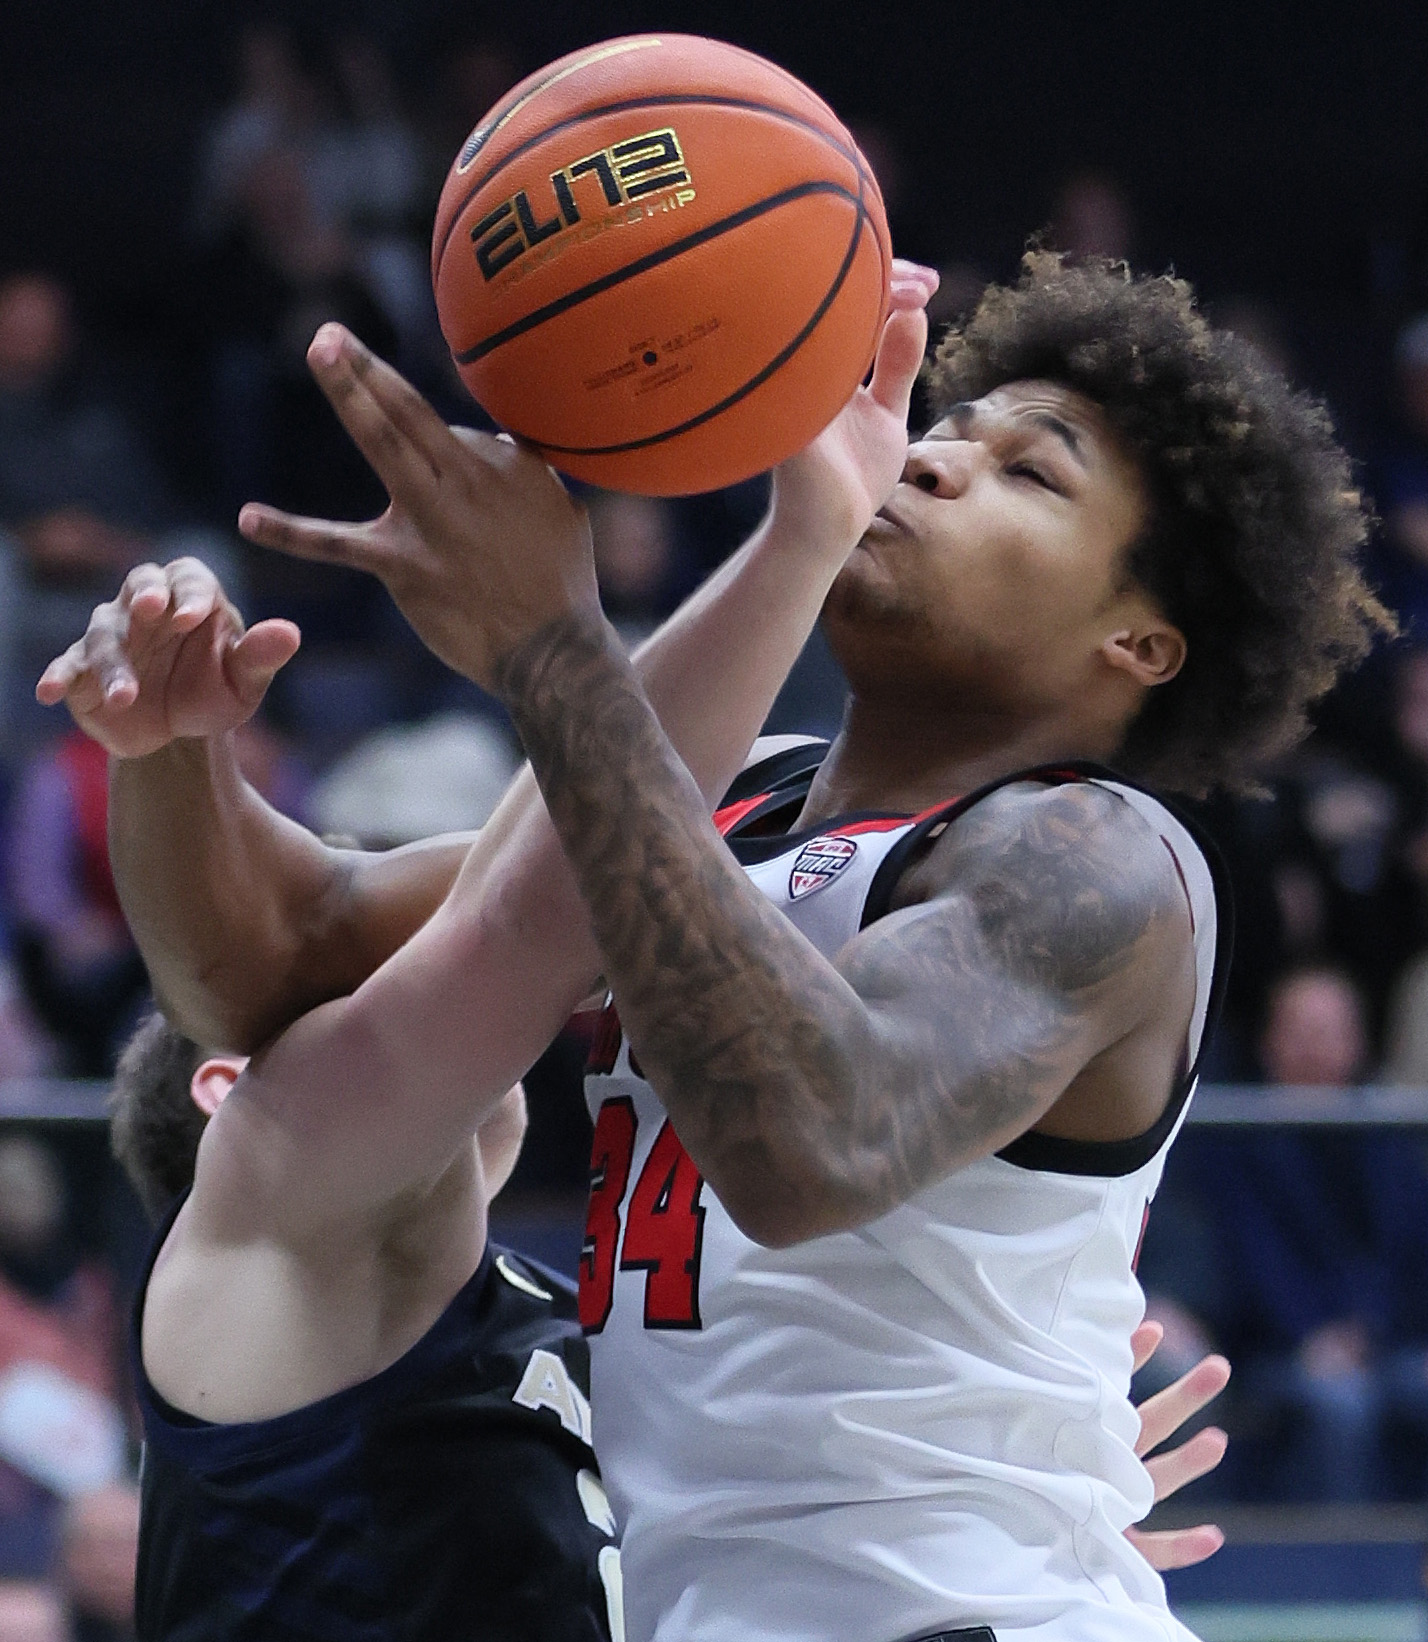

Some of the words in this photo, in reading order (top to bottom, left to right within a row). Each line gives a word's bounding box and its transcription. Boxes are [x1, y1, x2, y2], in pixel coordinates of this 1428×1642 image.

[470, 126, 692, 282] ELITE
[796, 854, 847, 874] MAC
[578, 1095, 703, 1336] 34
[512, 1349, 592, 1446] A
